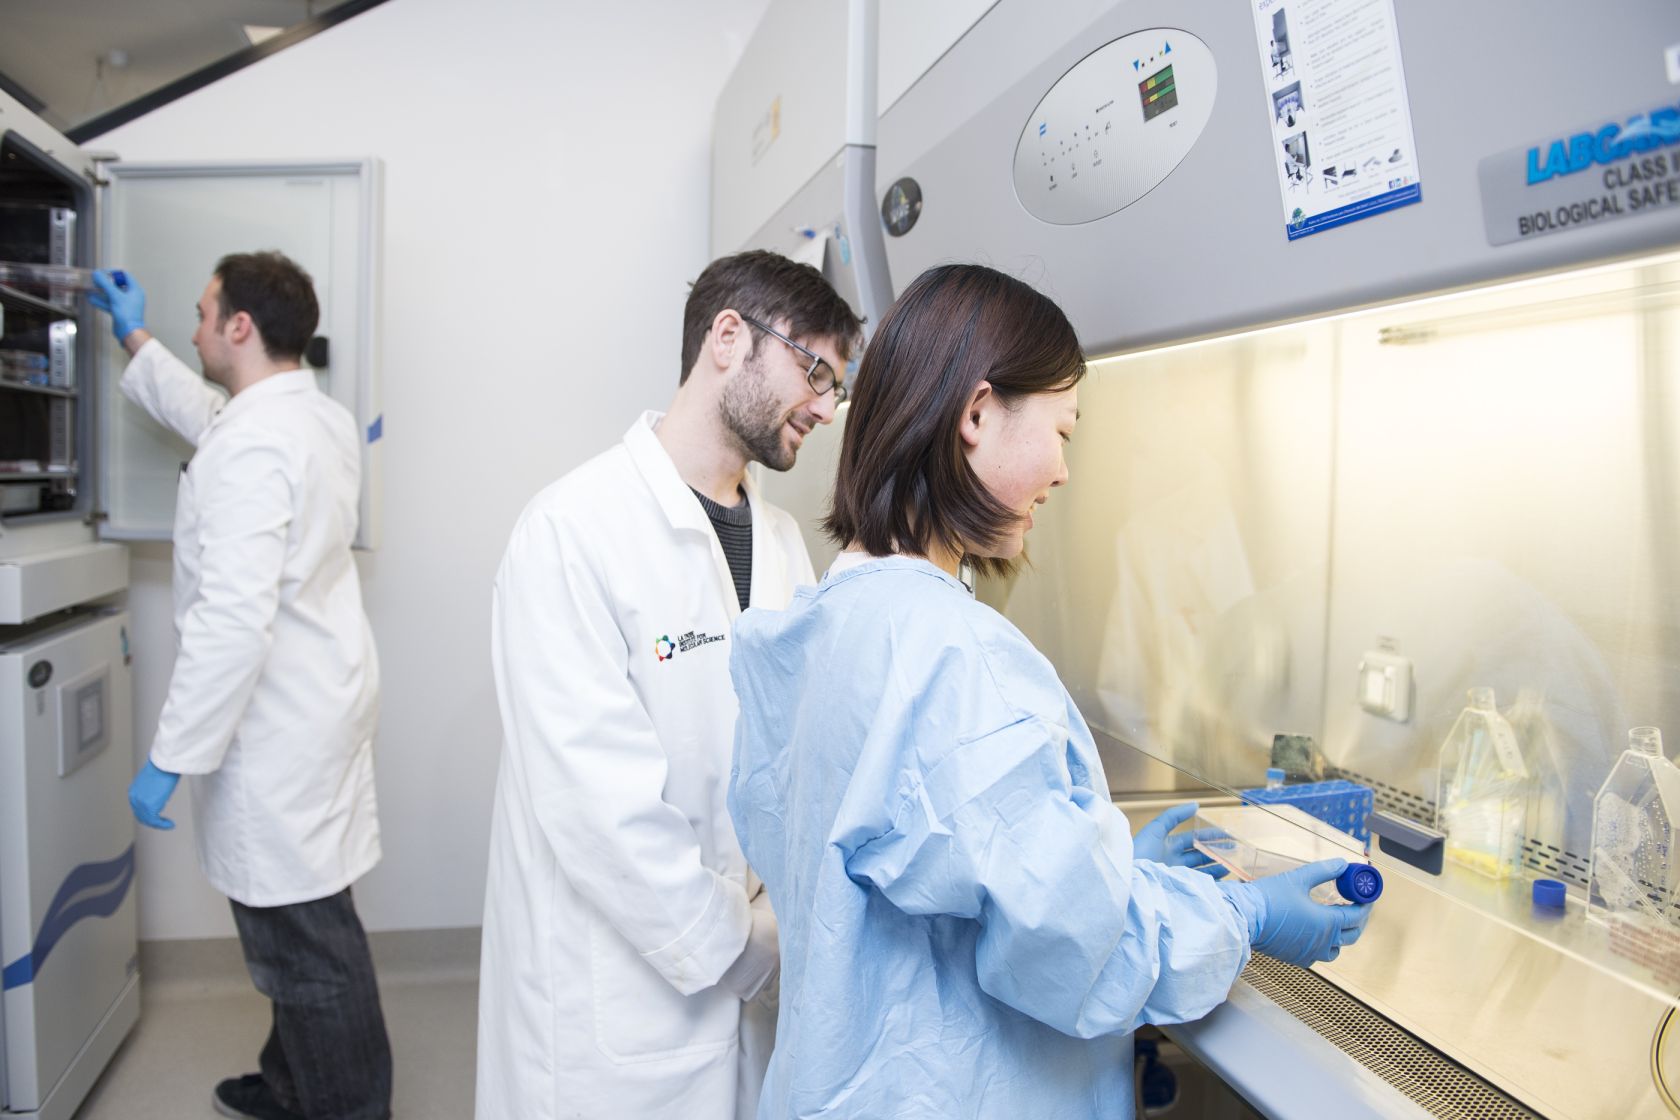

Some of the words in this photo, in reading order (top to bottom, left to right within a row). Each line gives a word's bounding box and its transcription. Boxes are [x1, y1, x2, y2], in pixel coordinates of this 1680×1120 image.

[1603, 154, 1667, 190] CLASS
[1518, 195, 1624, 236] BIOLOGICAL
[702, 634, 725, 645] SCIENCE
